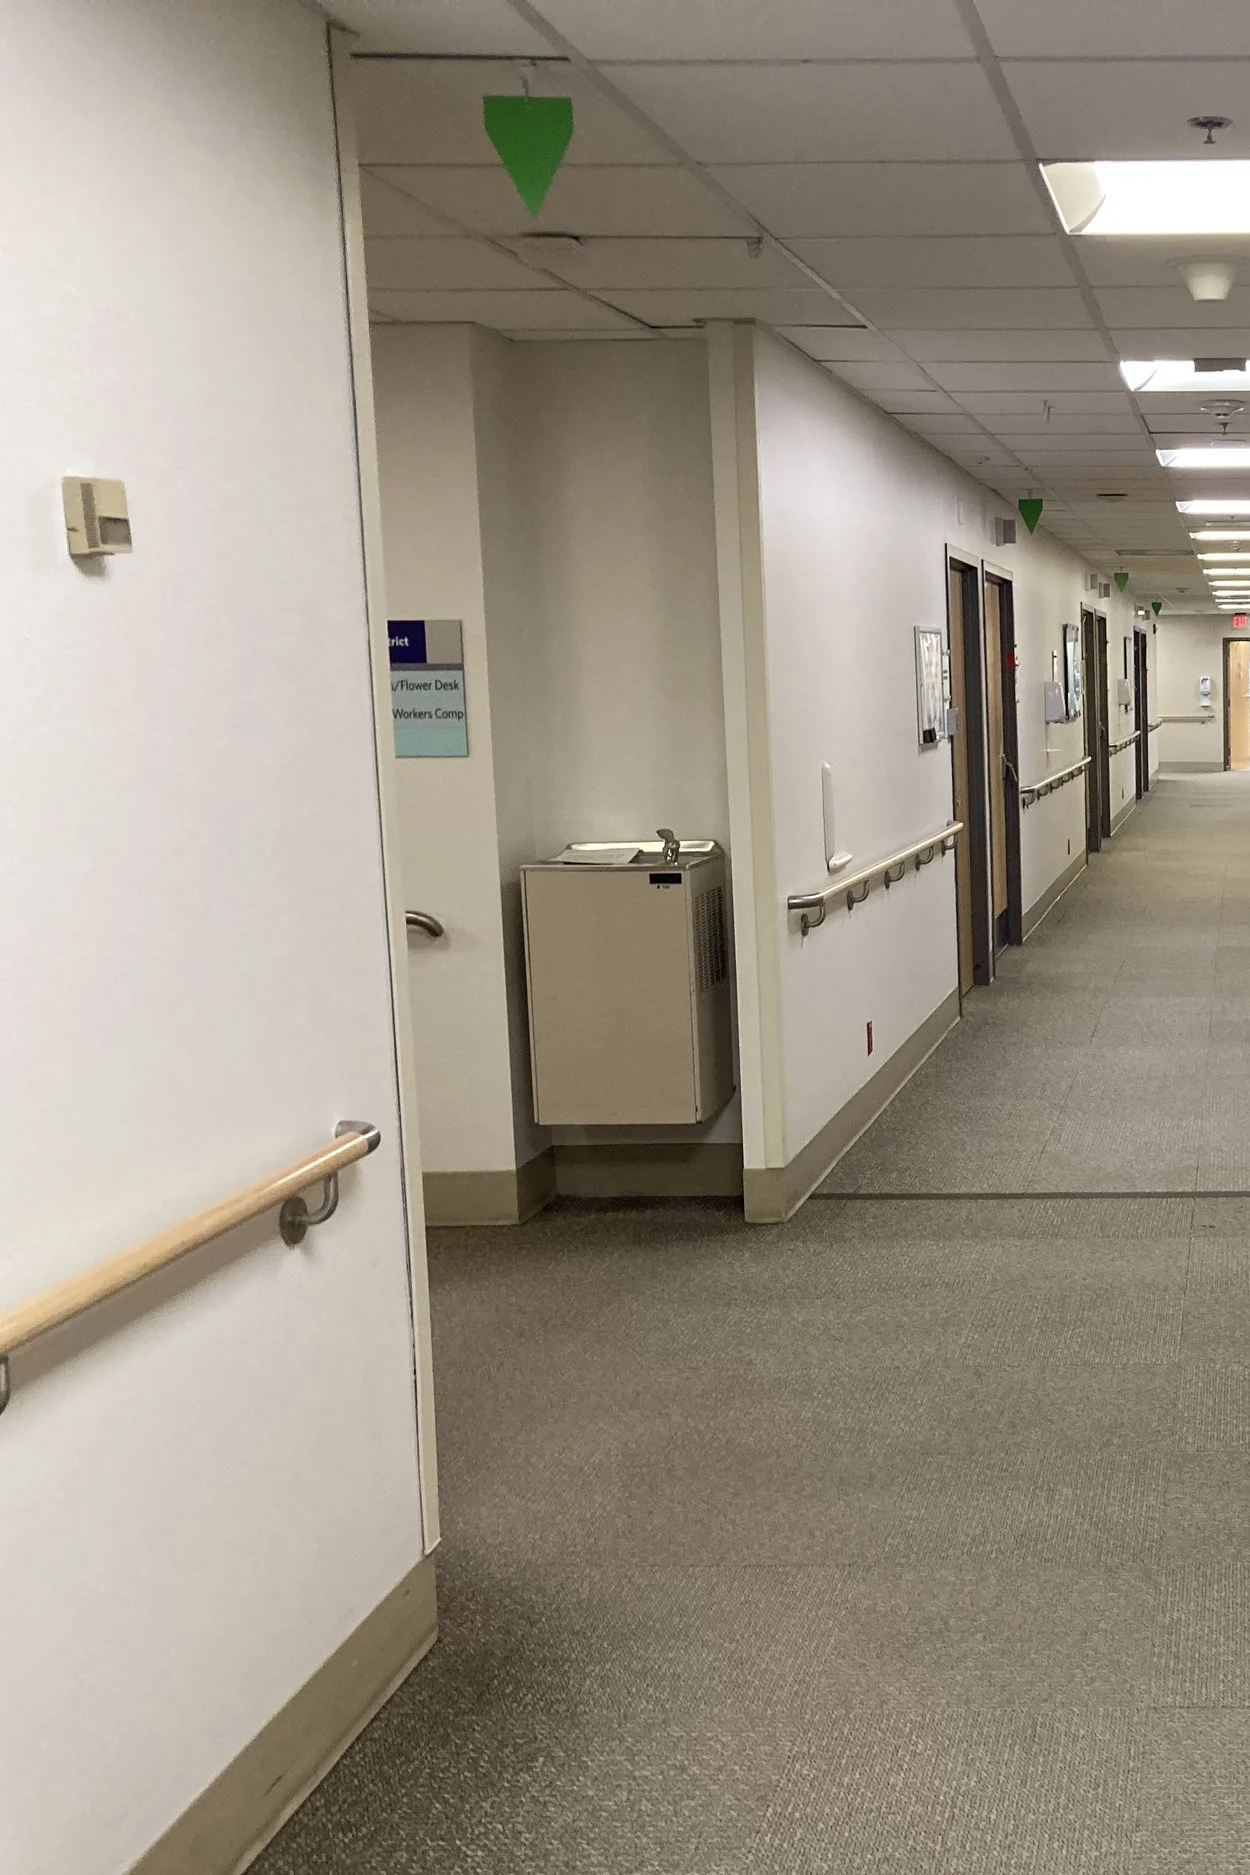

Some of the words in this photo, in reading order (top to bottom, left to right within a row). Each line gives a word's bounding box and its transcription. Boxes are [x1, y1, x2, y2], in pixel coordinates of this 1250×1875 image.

[1232, 615, 1248, 628] EXIT
[434, 679, 459, 691] Desk
[392, 707, 433, 719] Workers
[434, 707, 464, 720] Comp
